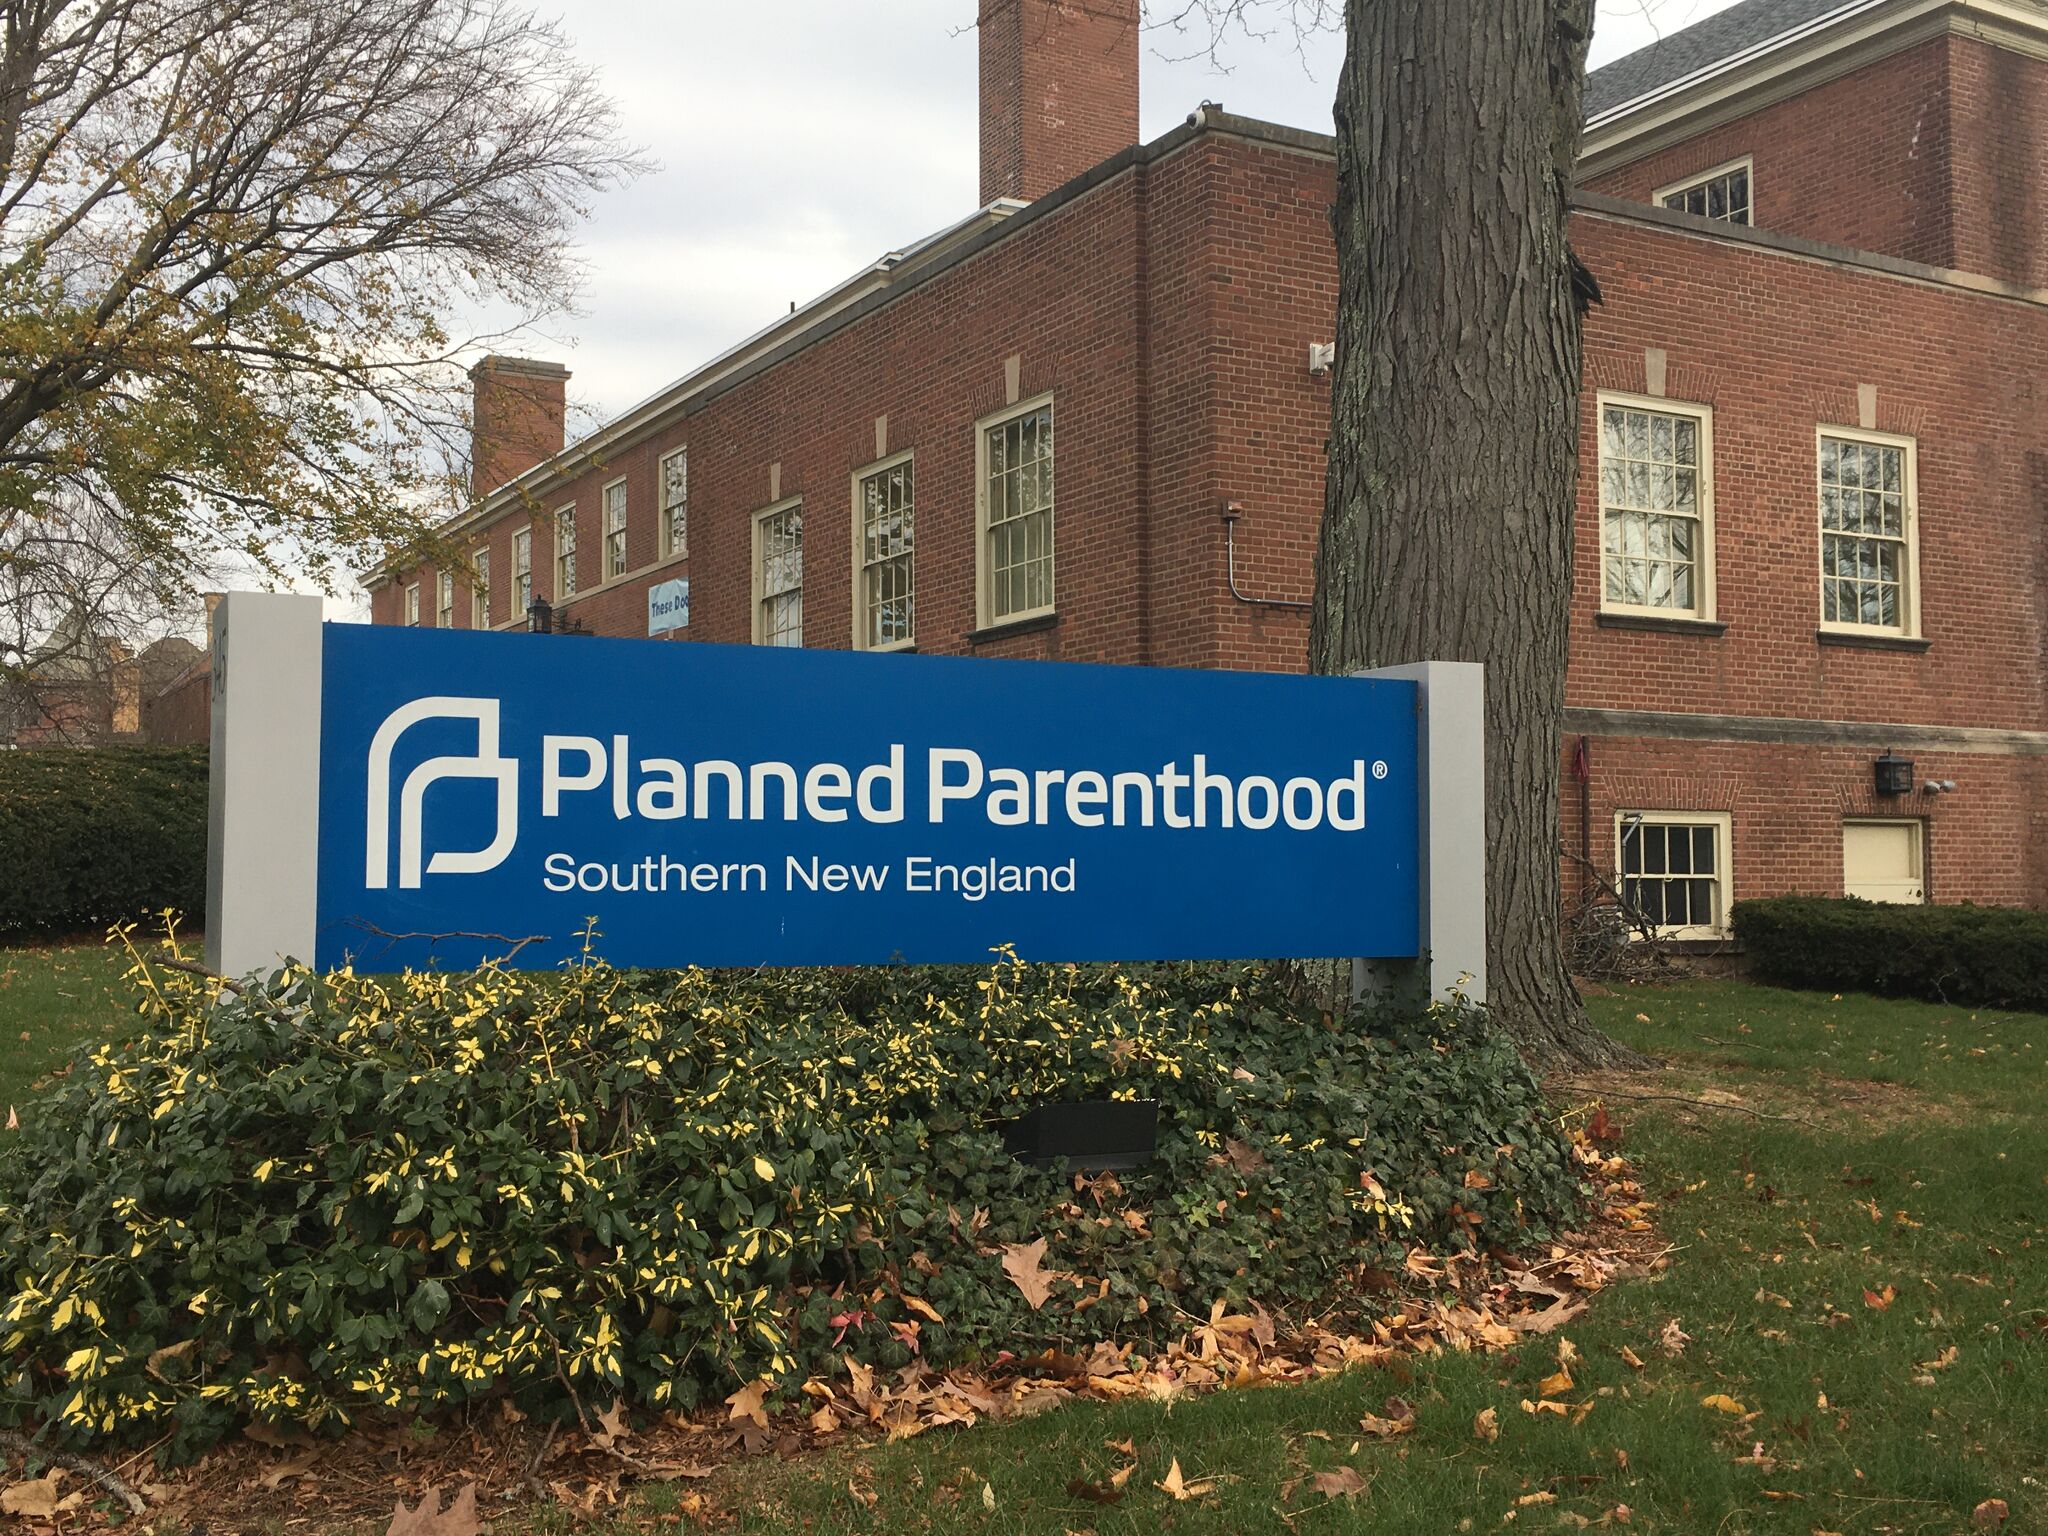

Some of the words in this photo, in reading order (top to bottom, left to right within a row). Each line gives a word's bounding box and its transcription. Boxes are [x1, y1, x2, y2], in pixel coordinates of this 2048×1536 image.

[652, 601, 674, 618] These
[542, 734, 904, 824] Planned
[543, 853, 767, 892] Southern
[786, 855, 890, 892] New
[906, 856, 1076, 901] England
